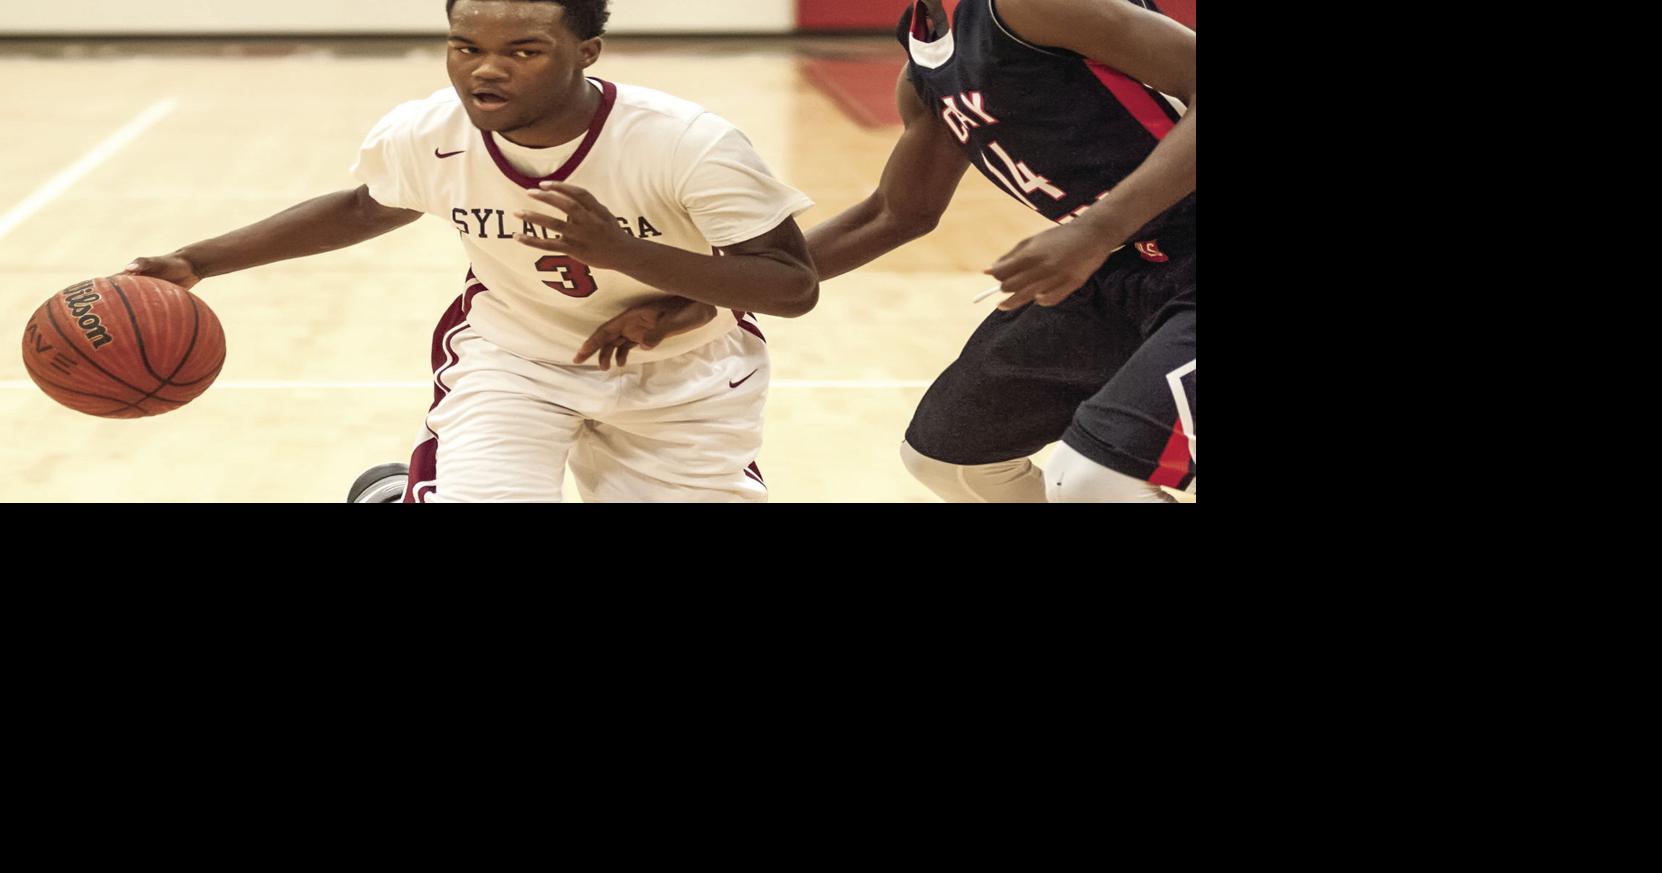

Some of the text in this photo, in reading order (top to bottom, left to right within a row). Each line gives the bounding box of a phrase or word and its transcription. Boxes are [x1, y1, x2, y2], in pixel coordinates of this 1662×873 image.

[981, 141, 1067, 211] 14
[452, 207, 662, 239] SYLACGA
[535, 255, 599, 298] 3
